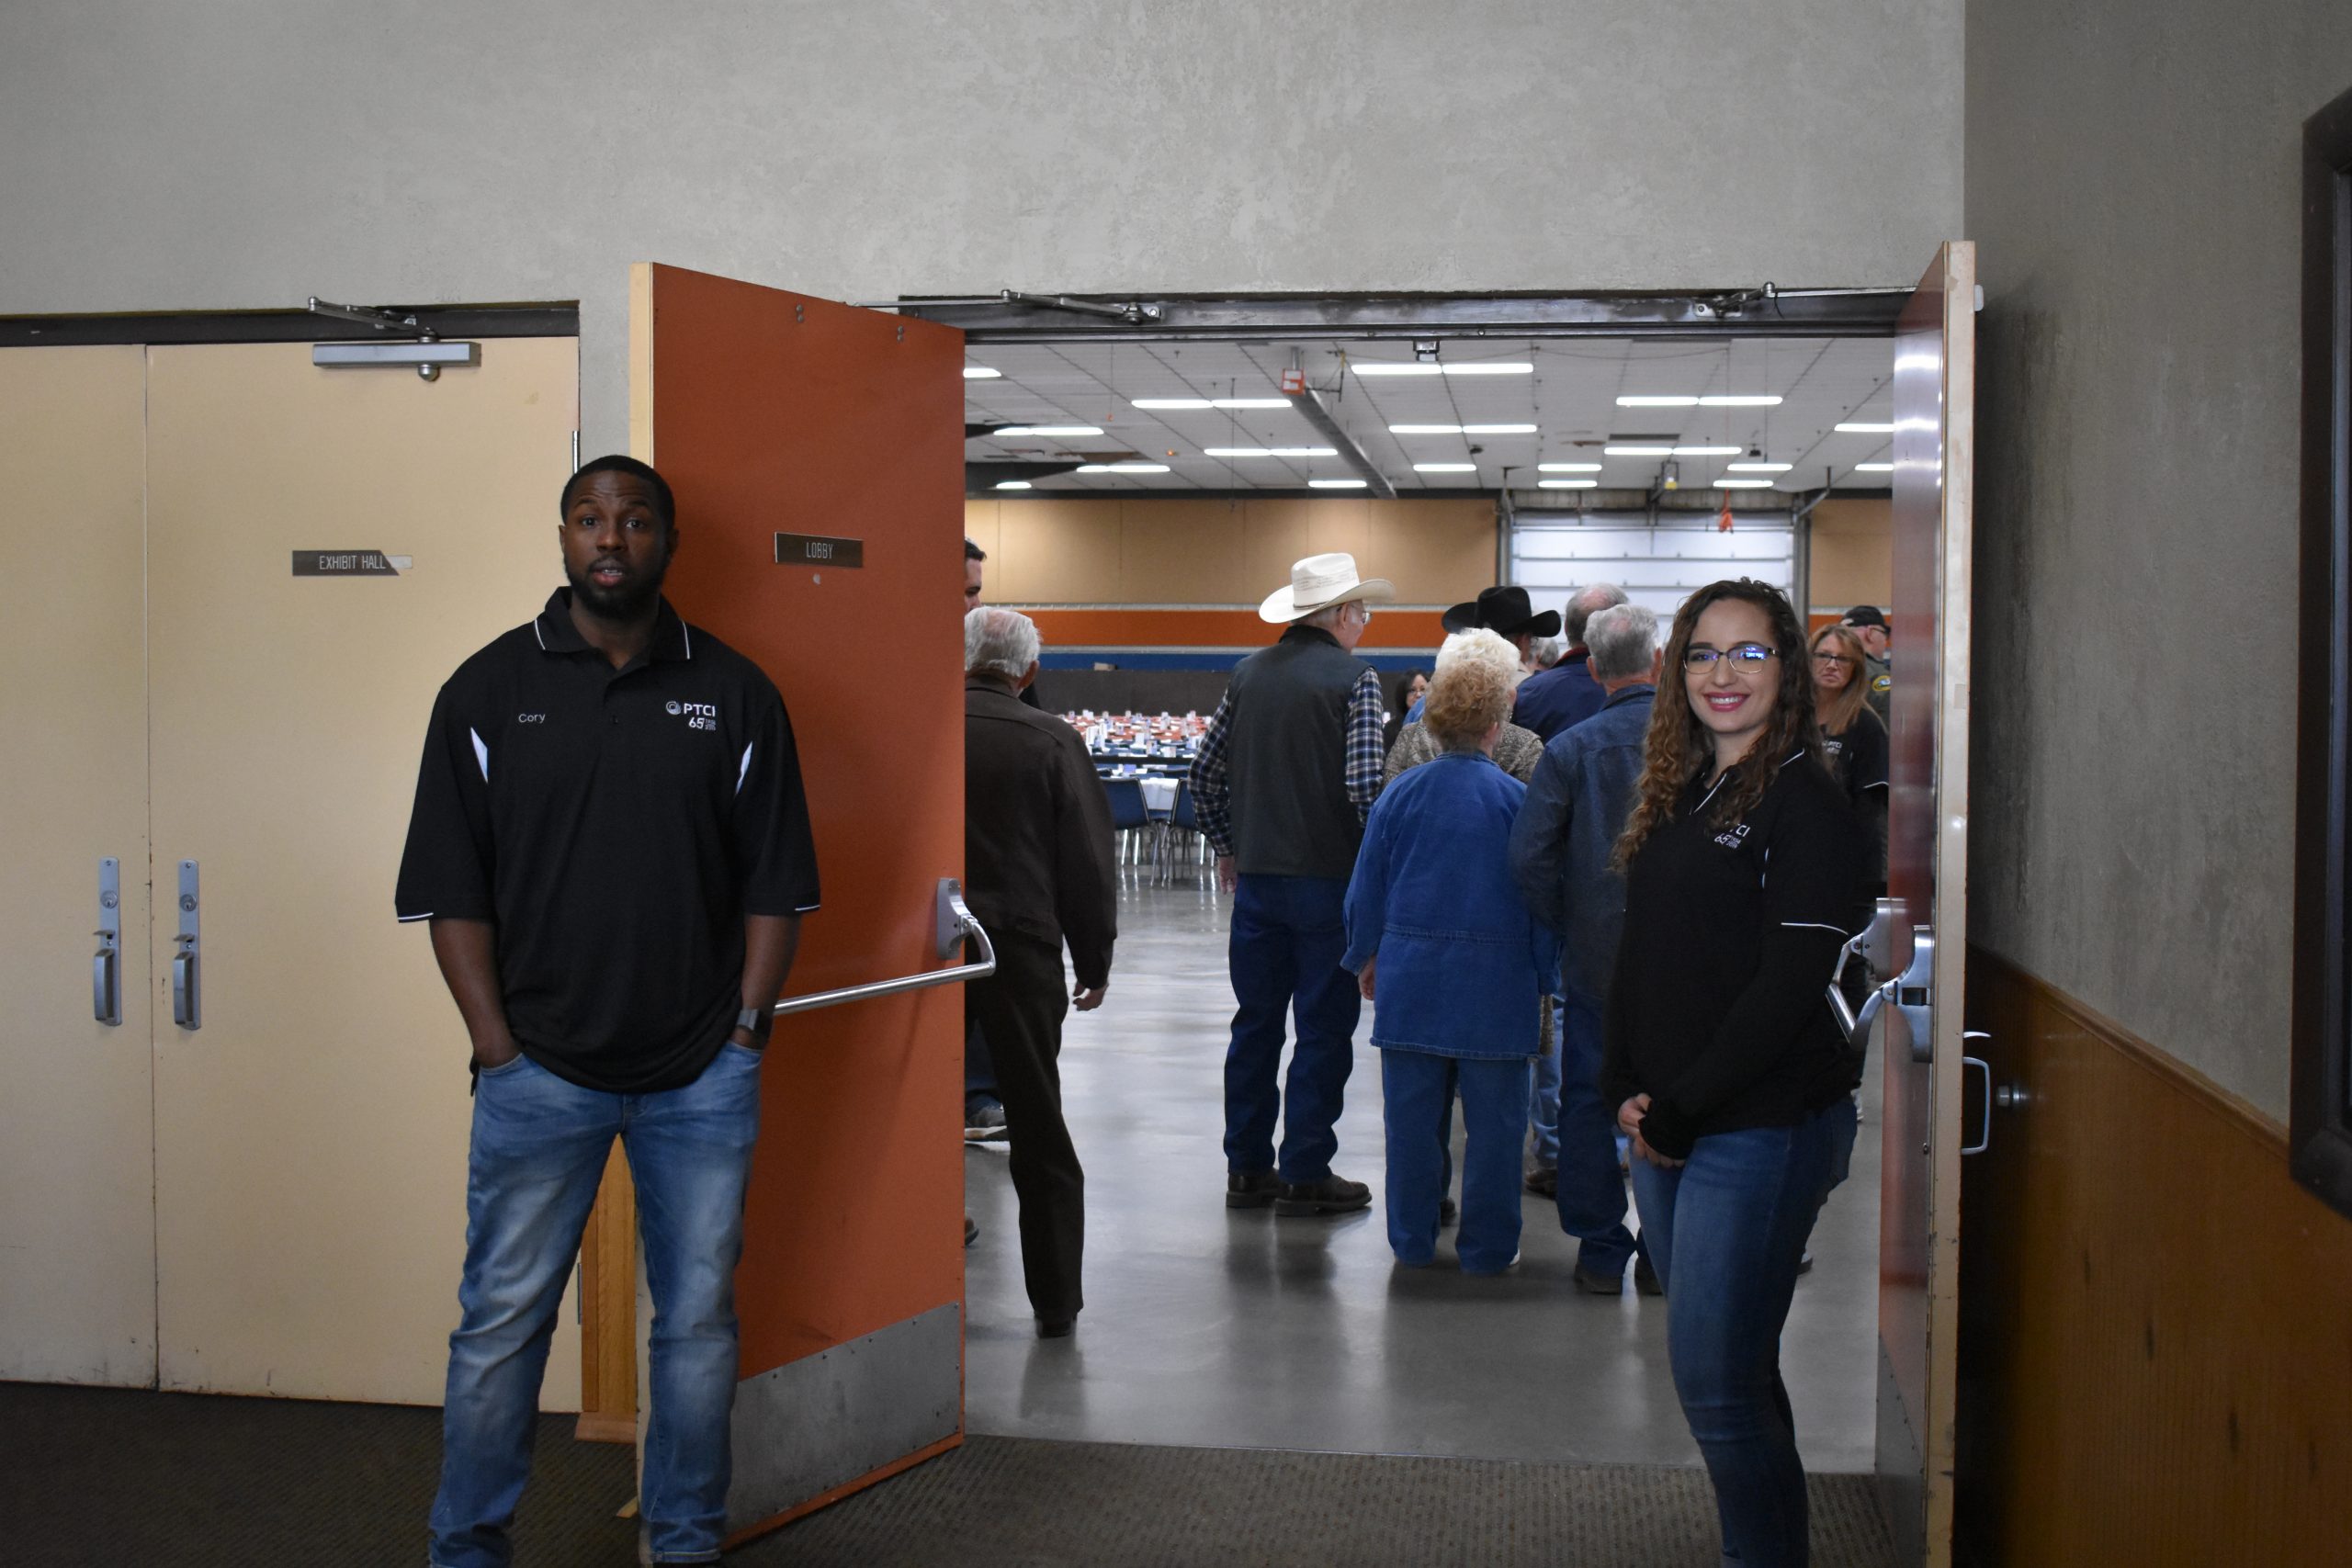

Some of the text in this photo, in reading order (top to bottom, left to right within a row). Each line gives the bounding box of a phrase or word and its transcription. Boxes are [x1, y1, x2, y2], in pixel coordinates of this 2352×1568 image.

[806, 542, 833, 559] LOBBY
[319, 555, 387, 570] EXHIBIT HALL
[684, 703, 716, 717] PTCI
[518, 713, 546, 724] Cory
[689, 716, 705, 729] 65
